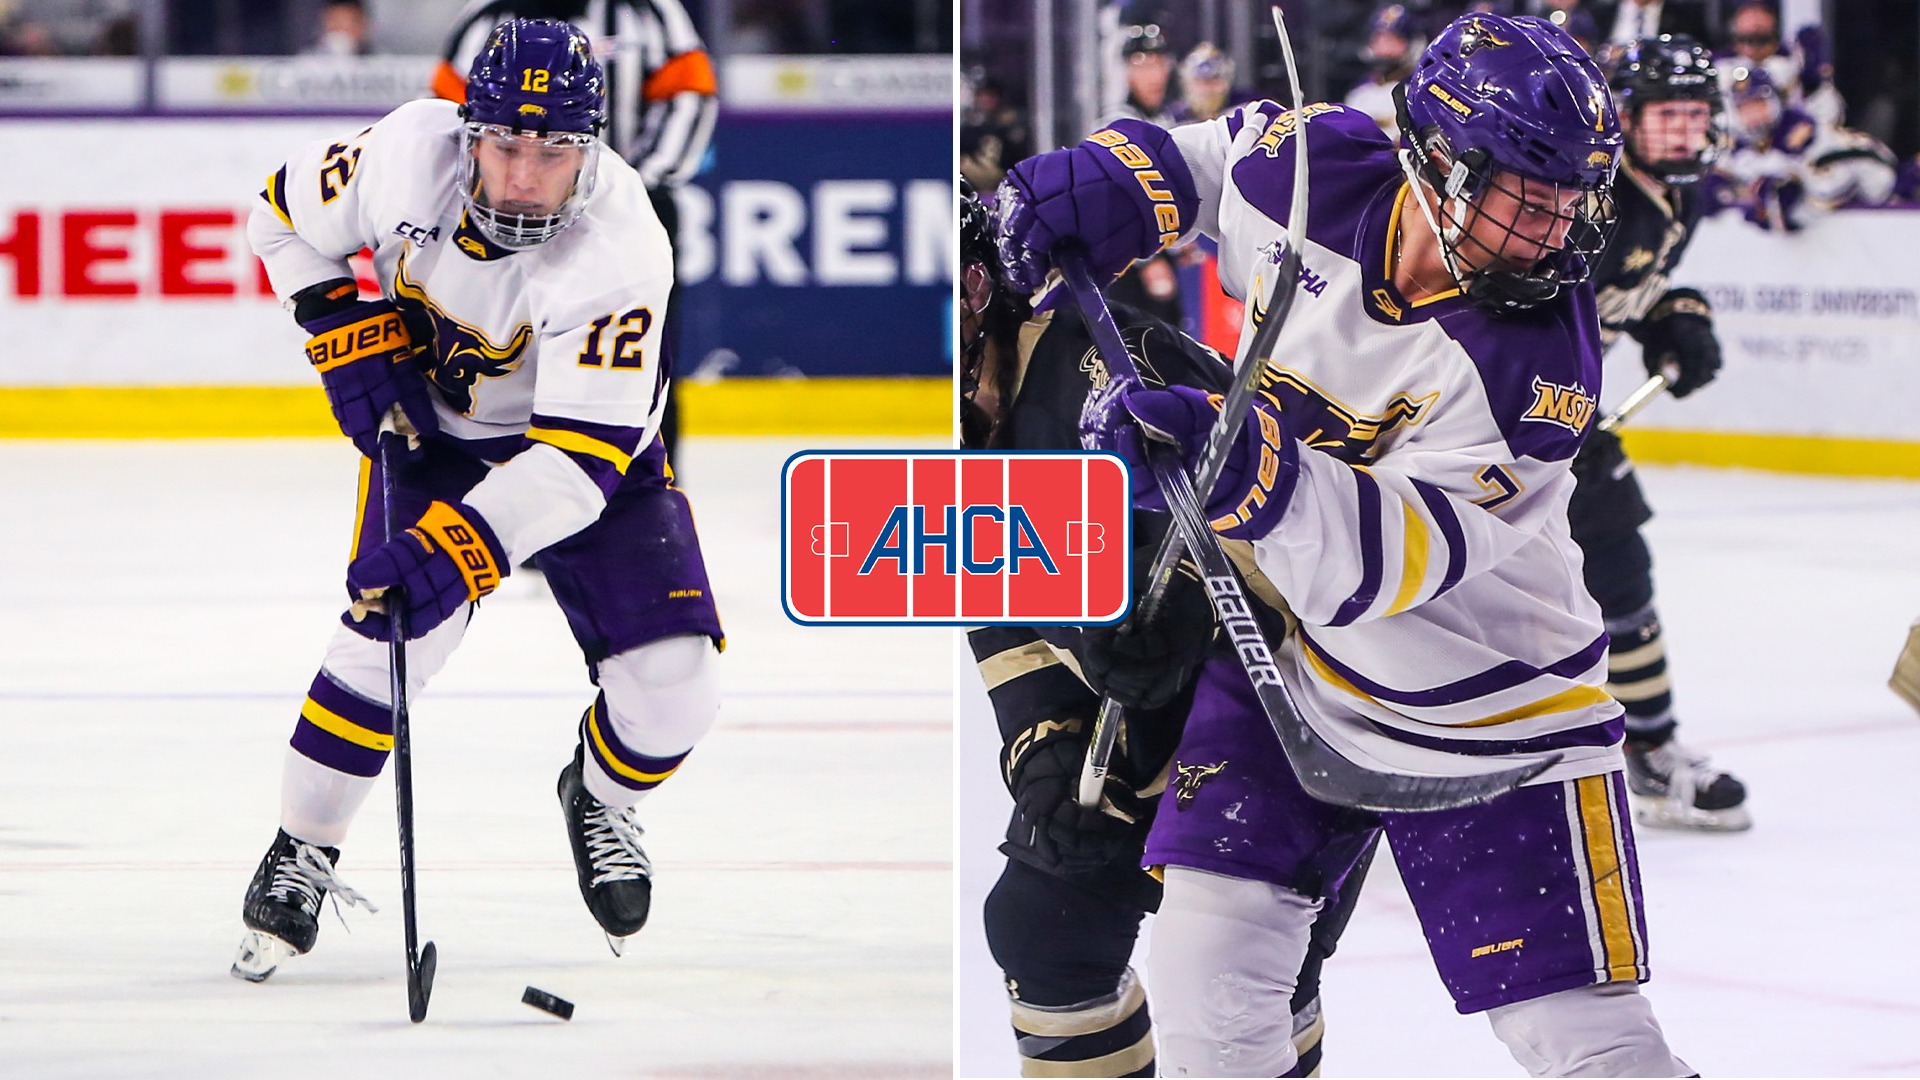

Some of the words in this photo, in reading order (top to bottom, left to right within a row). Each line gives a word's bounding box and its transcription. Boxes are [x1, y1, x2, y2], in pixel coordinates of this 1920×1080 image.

[520, 67, 550, 93] 12
[1408, 129, 1429, 165] AUER
[577, 304, 654, 372] 12
[1520, 374, 1597, 438] MSU
